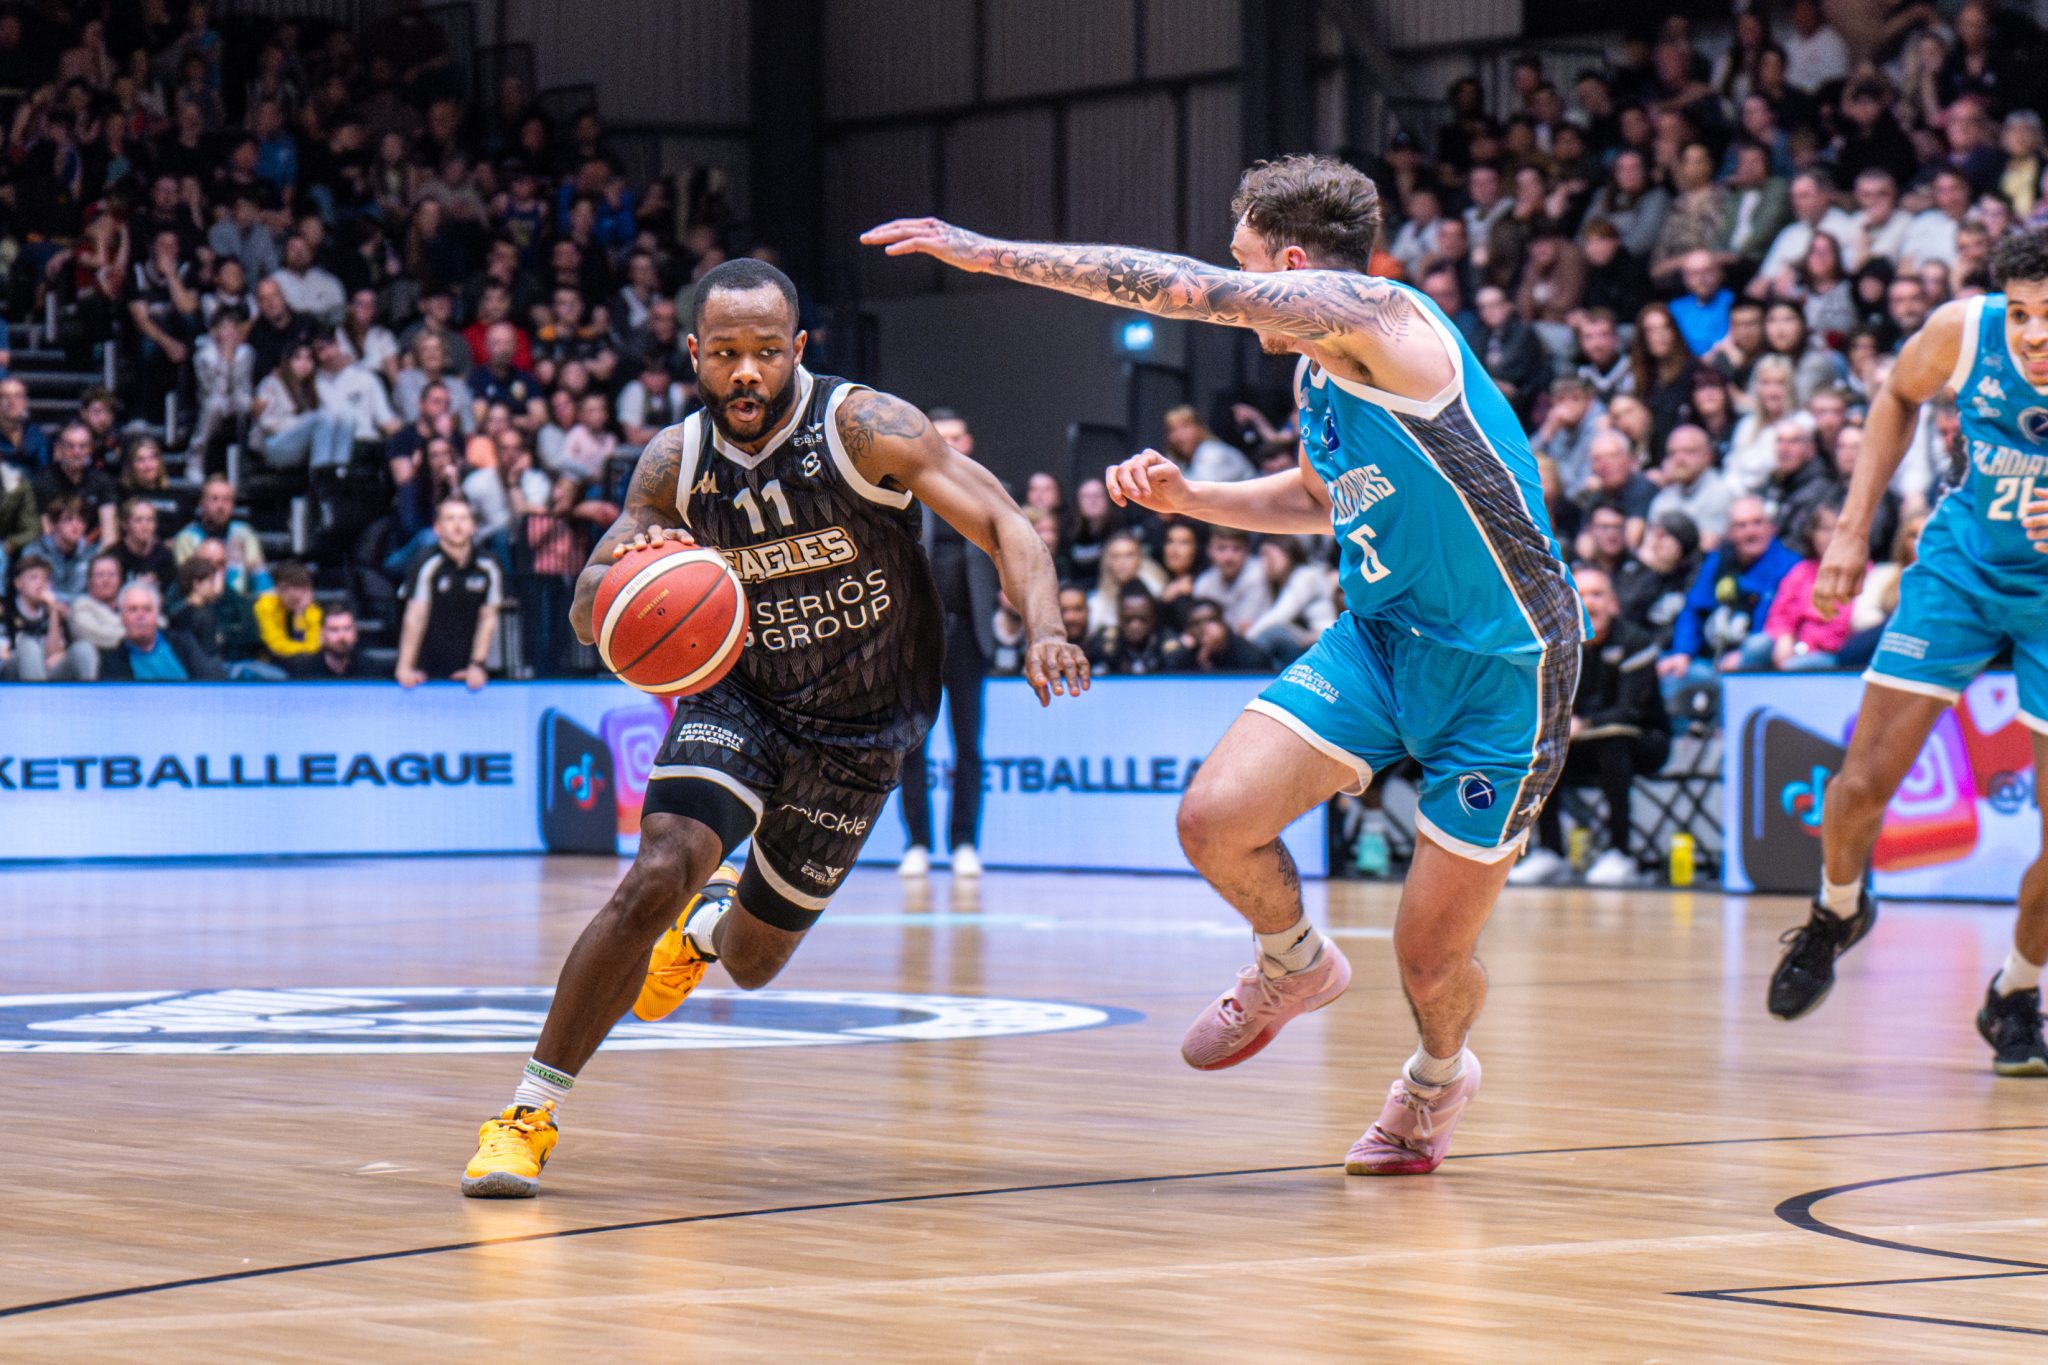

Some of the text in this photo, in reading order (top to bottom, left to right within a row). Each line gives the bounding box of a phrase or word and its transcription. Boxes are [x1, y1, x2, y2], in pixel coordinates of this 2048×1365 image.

[733, 479, 794, 534] 11
[721, 530, 854, 580] EAGLES
[1347, 523, 1392, 584] 6
[757, 569, 887, 625] SERIÖS
[762, 595, 891, 650] GROUP
[1282, 675, 1337, 704] LEAGUE
[680, 729, 741, 749] BASKETBALL
[682, 722, 744, 744] BRITISH
